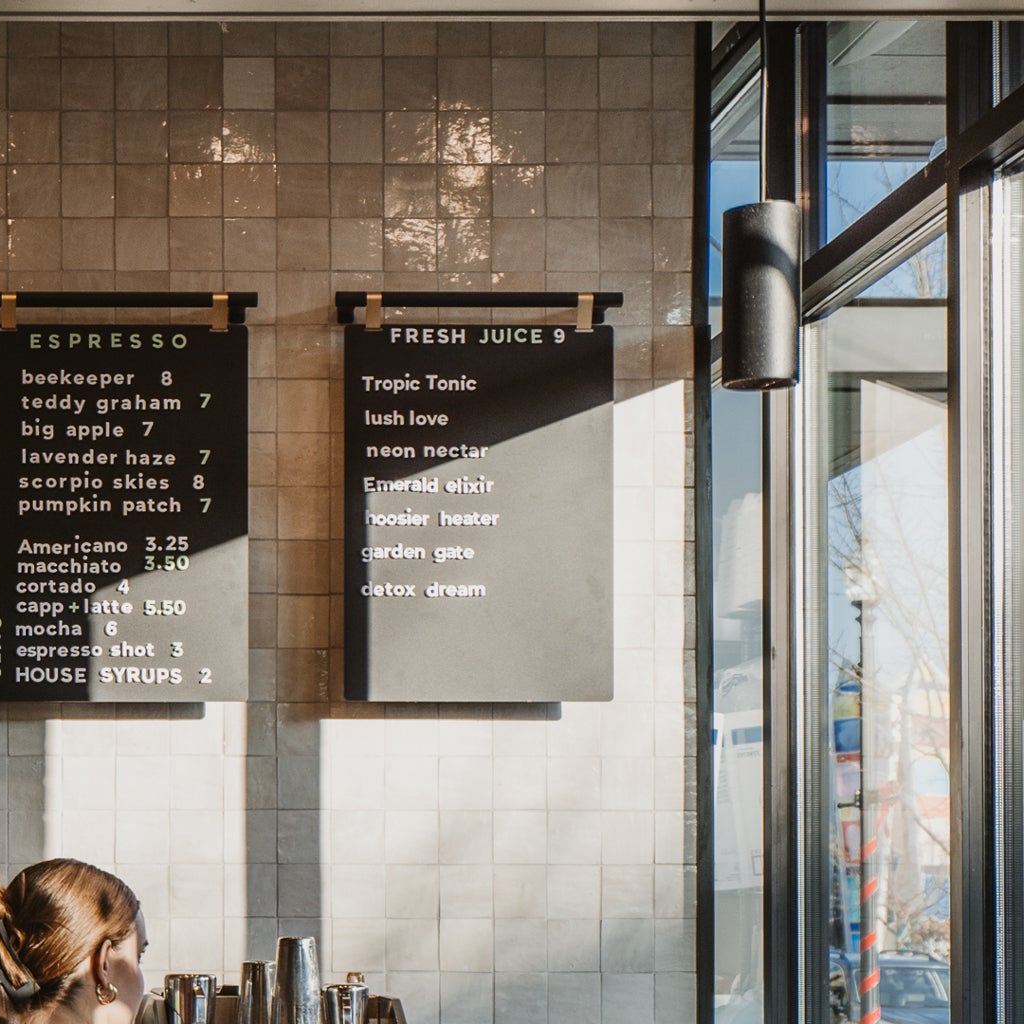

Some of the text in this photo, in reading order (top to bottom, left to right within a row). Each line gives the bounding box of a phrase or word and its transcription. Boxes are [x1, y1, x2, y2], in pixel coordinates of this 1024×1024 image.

[30, 333, 187, 350] ESPRESSO
[391, 328, 565, 344] FRESH JUICE 9
[22, 369, 173, 389] beekeeper 8
[362, 373, 477, 394] Tropic Tonic
[22, 393, 212, 415] teddy graham 7
[365, 410, 449, 426] lush love
[21, 418, 154, 441] big apple 7
[21, 448, 211, 466] lavender haze 7
[367, 443, 489, 458] neon nectar
[19, 470, 205, 492] scorpio skies 8
[363, 476, 494, 494] Emerald elixir
[18, 494, 212, 516] pumpkin patch 7
[365, 508, 499, 526] hoosier heater
[17, 535, 189, 555] Americano 3.25
[361, 543, 475, 563] garden gate
[17, 556, 190, 574] macchiato 3.50
[16, 578, 129, 594] cortado 4
[361, 581, 486, 598] detox dream
[16, 601, 64, 617] capp
[84, 599, 133, 614] latte
[144, 600, 187, 616] 5.50
[15, 621, 118, 637] mocha 6
[16, 641, 184, 661] espresso shot 3
[15, 667, 212, 684] HOUSE SYRUPS 2
